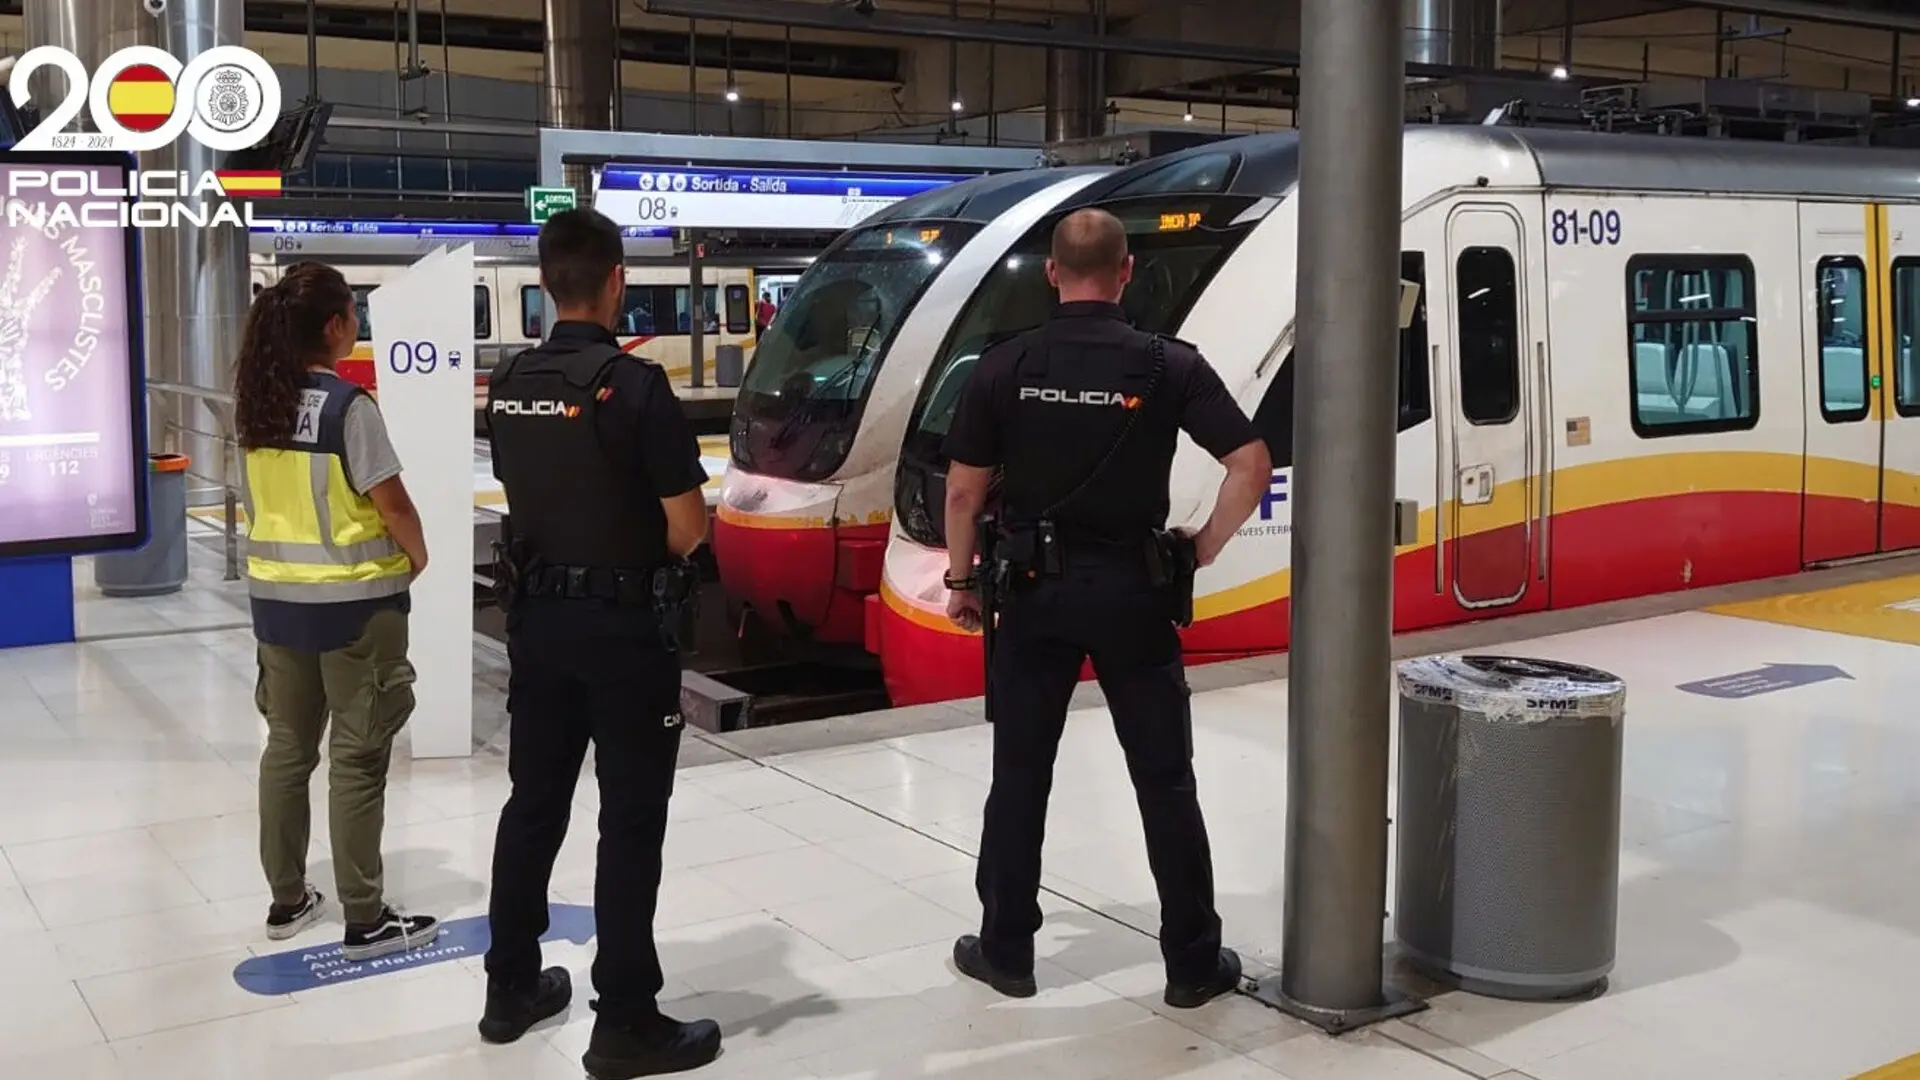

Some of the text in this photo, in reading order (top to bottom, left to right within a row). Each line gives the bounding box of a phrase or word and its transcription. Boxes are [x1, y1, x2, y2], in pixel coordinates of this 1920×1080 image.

[691, 176, 739, 191] Sortida
[750, 176, 787, 192] Salida
[638, 197, 667, 220] 08
[1552, 208, 1621, 245] 81-09
[274, 235, 294, 251] 06
[45, 235, 105, 392] MASCLISTES
[390, 341, 437, 374] 09
[493, 400, 567, 416] POLICIA
[1020, 387, 1126, 406] POLICIA
[48, 460, 80, 476] 112
[1260, 474, 1288, 521] F
[316, 965, 363, 980] Low
[371, 944, 466, 970] Platform
